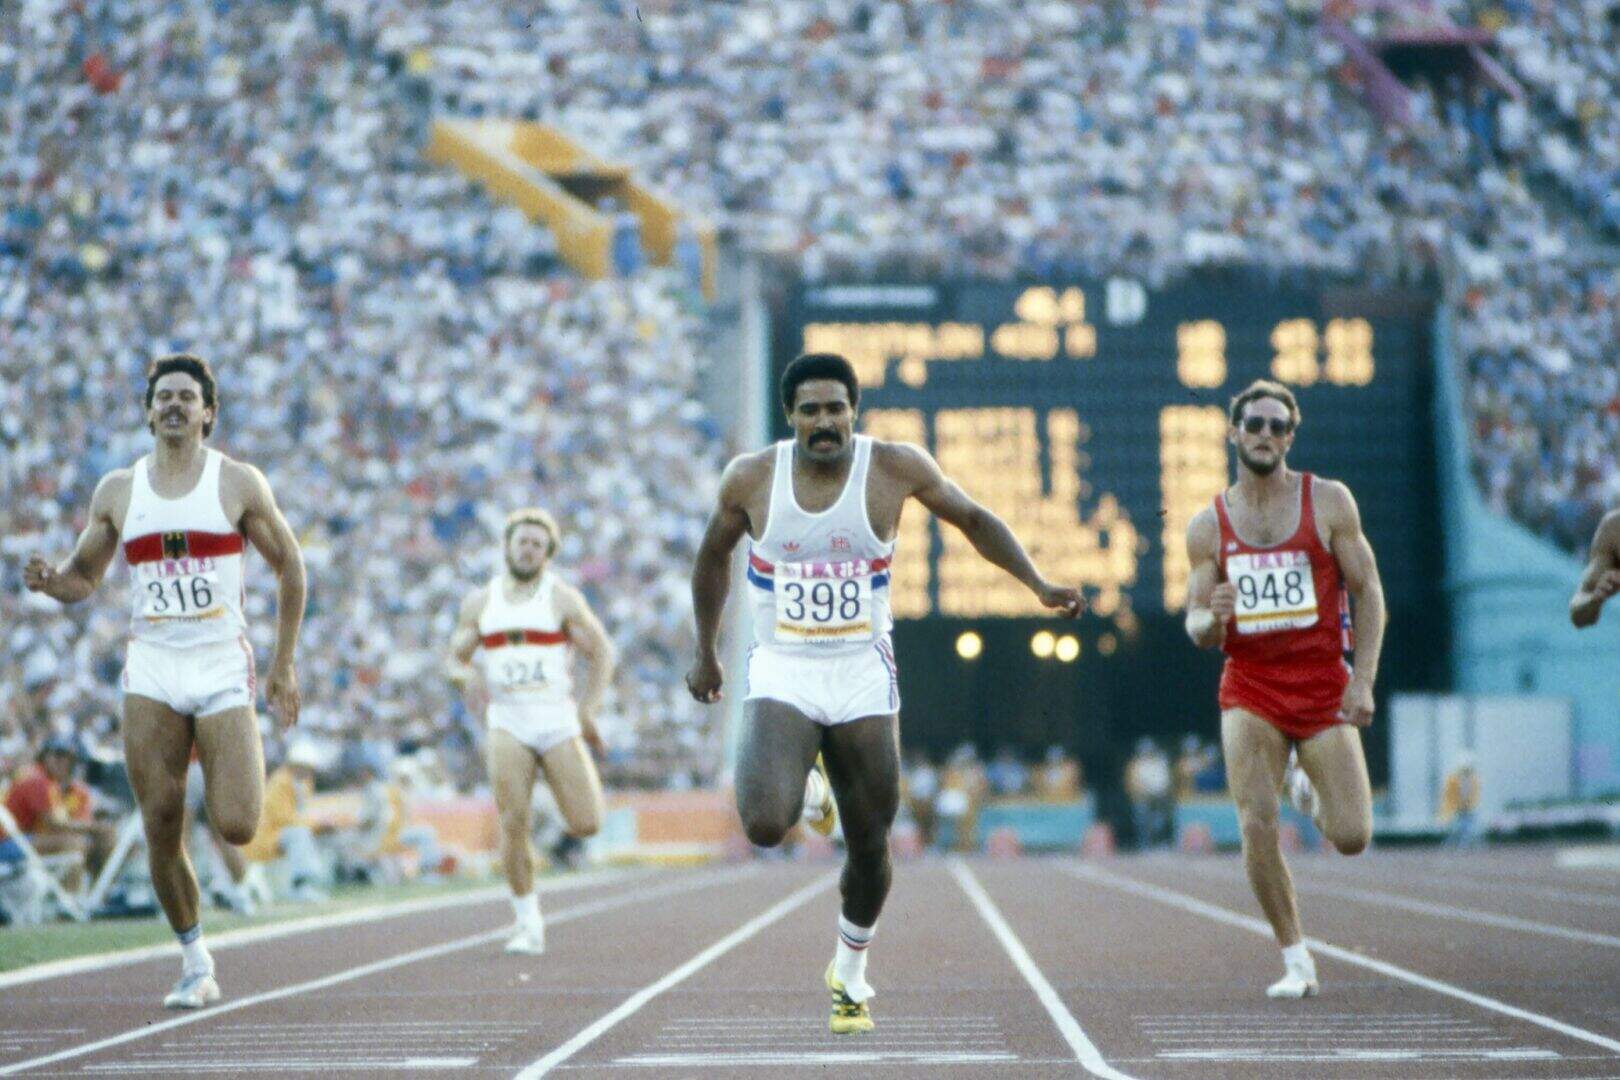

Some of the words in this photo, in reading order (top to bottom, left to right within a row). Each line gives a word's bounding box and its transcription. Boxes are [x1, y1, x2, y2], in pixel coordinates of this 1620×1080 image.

[148, 577, 212, 612] 316
[784, 580, 860, 622] 398
[1238, 570, 1304, 609] 948
